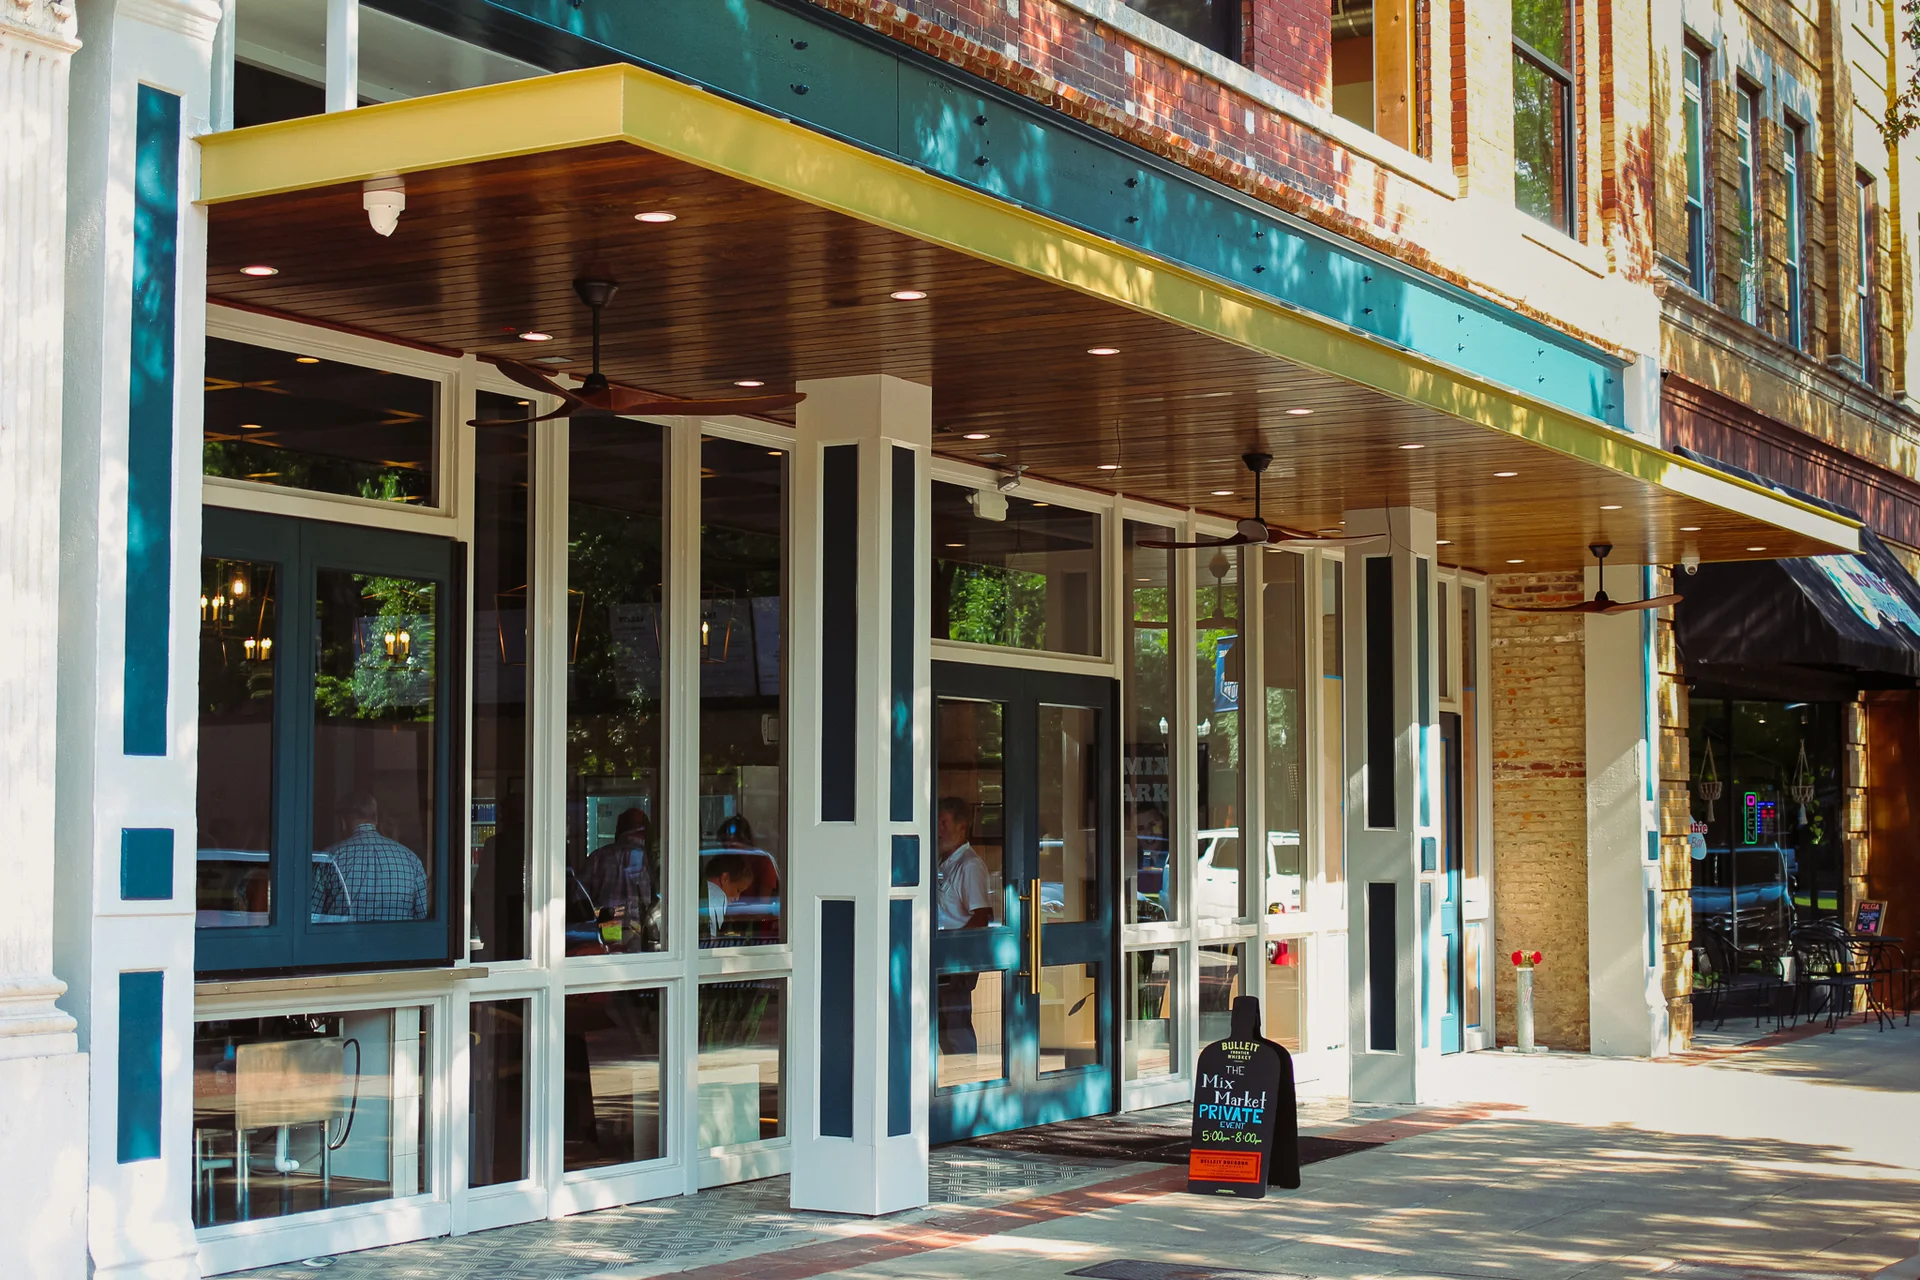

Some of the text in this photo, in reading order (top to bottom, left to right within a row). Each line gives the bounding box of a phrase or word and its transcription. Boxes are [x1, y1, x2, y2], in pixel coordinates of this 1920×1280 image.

[1746, 795, 1755, 841] OPEN
[1221, 1041, 1260, 1053] BULLEIT
[1225, 1065, 1245, 1076] THE
[1201, 1073, 1235, 1090] Mix
[1214, 1090, 1267, 1110] Market
[1199, 1104, 1264, 1125] PRIVATE
[1219, 1121, 1246, 1130] EVENT
